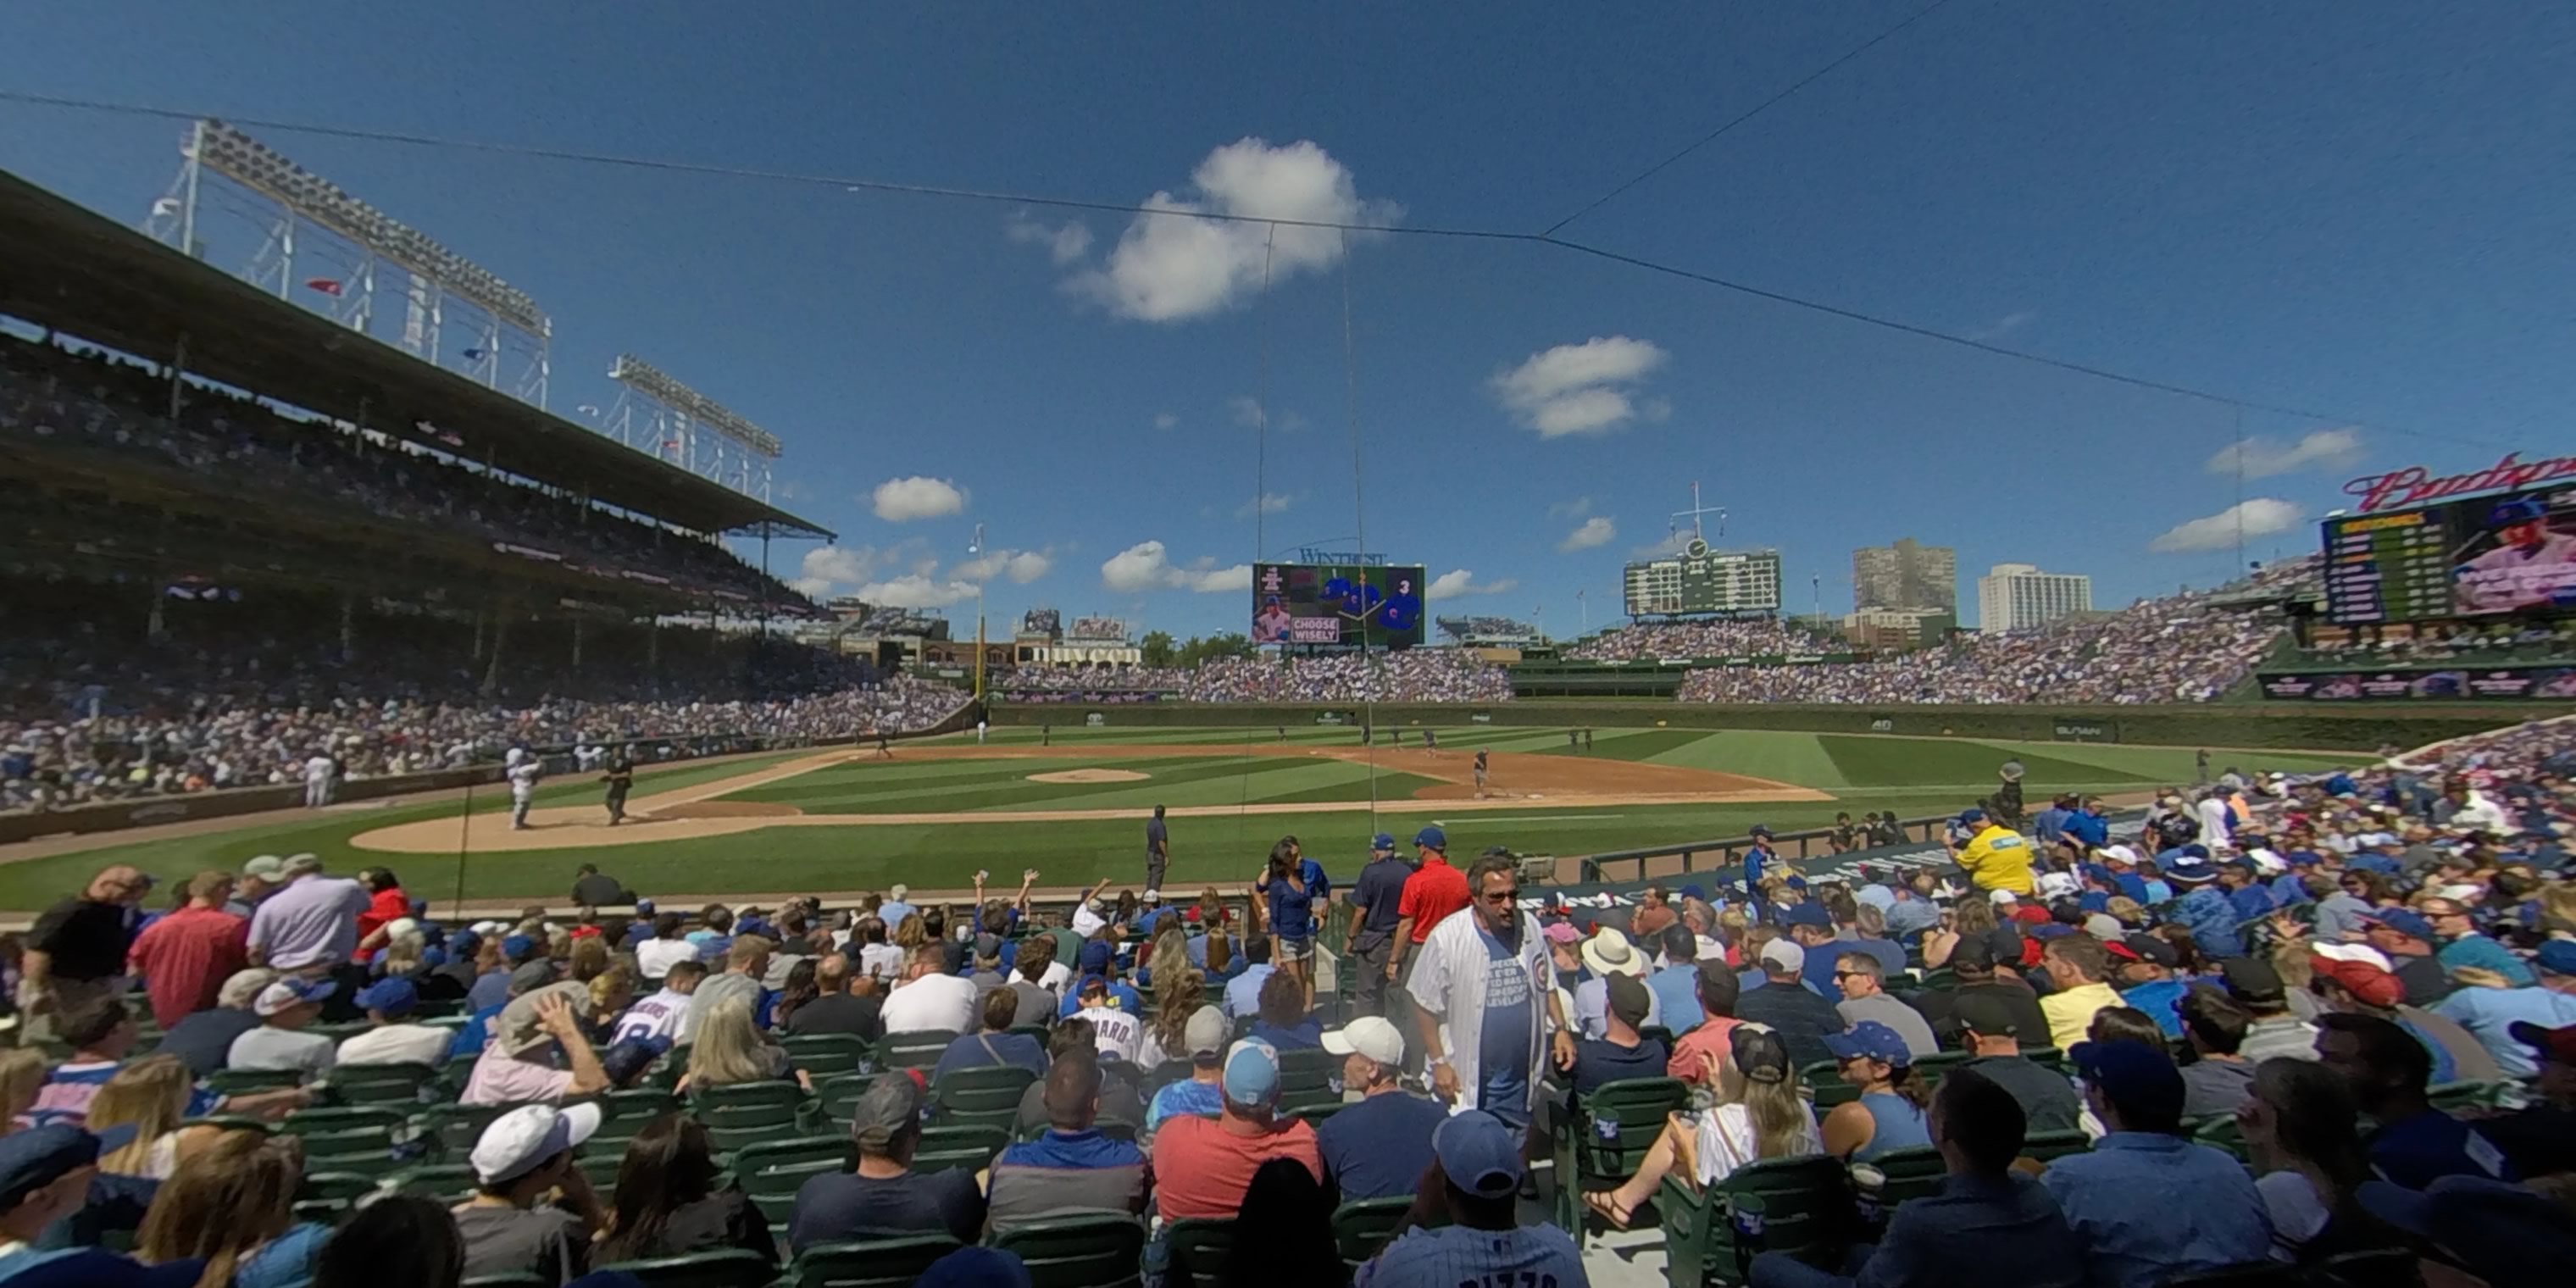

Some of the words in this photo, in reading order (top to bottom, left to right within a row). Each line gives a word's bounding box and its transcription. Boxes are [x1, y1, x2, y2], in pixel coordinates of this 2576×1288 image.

[1399, 580, 1410, 594] 3
[1293, 619, 1336, 630] CHOOSE
[1295, 630, 1335, 641] WISELY
